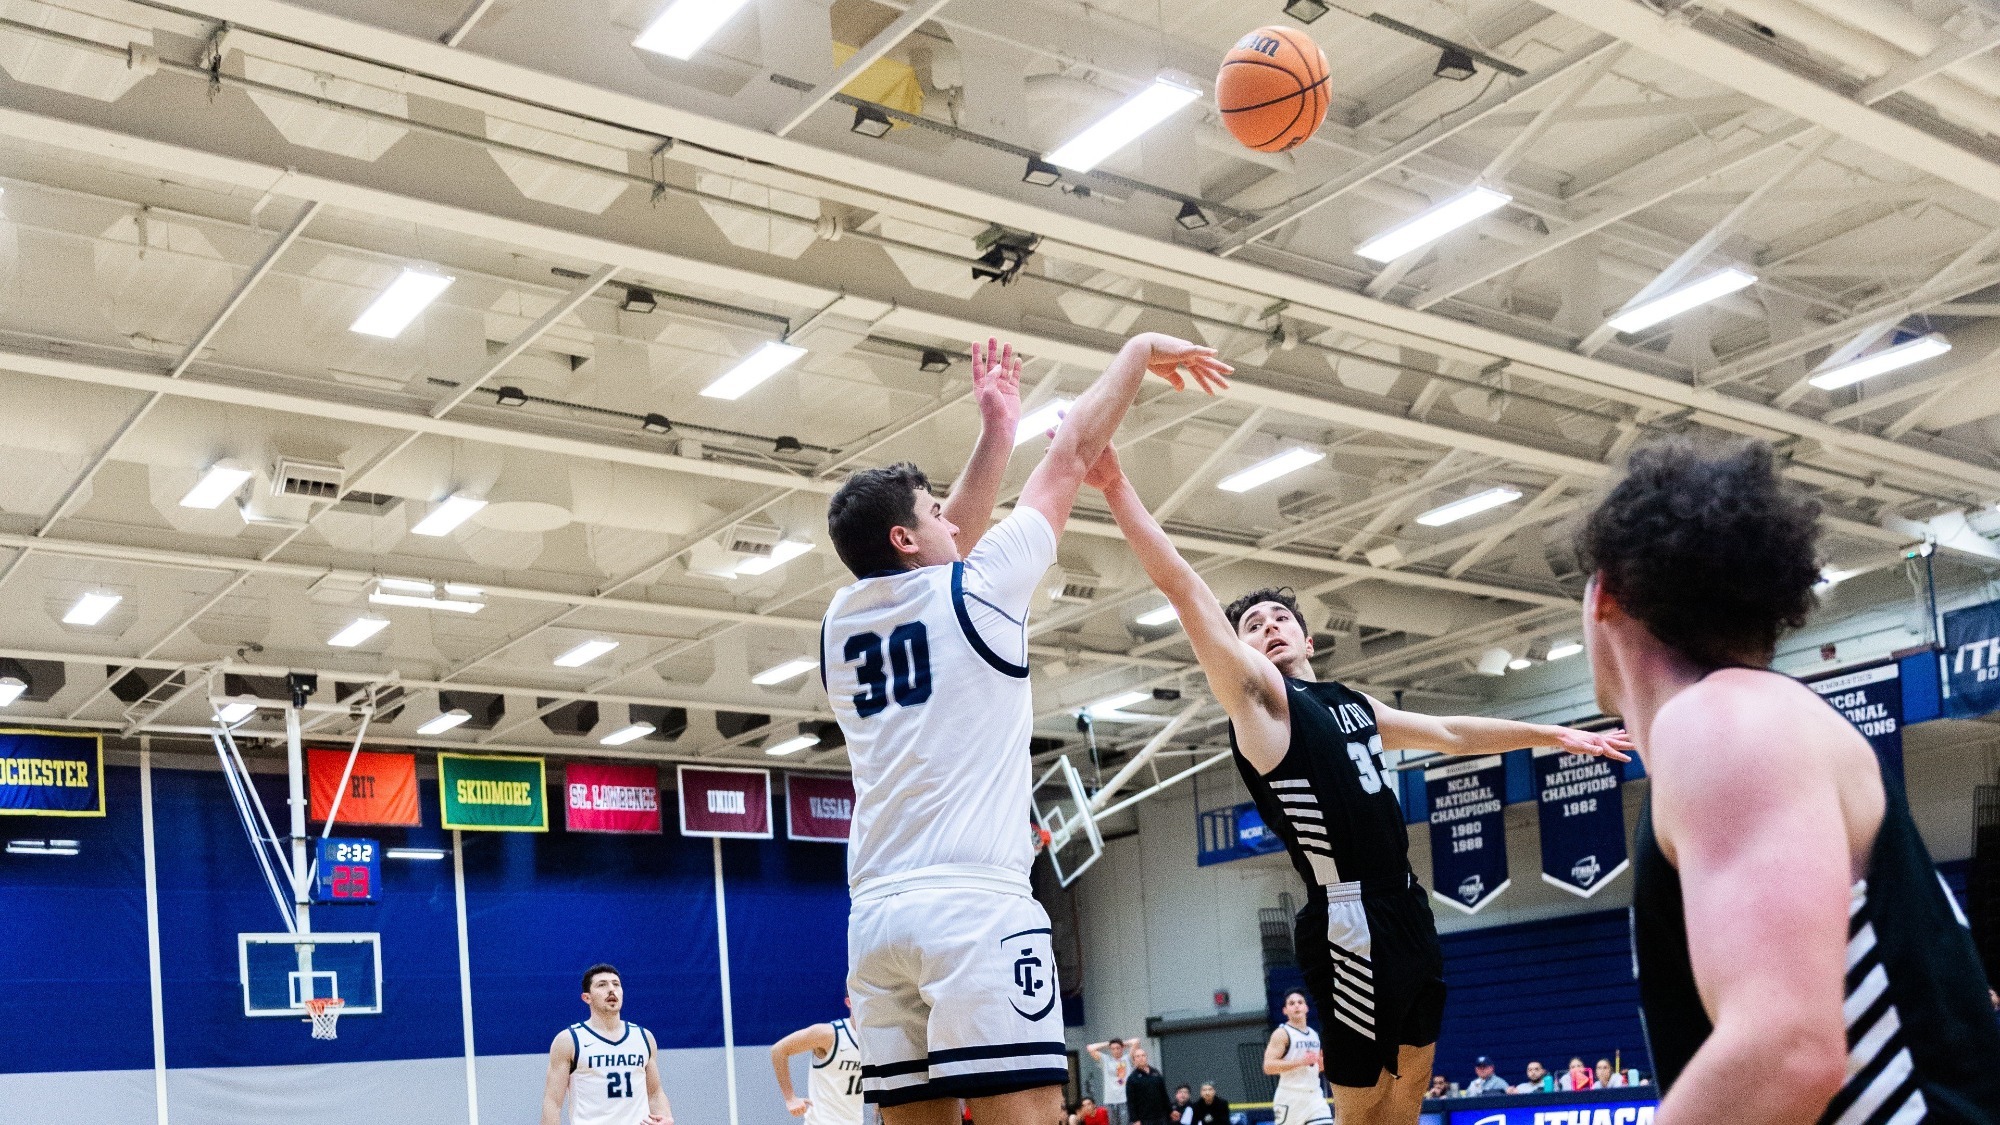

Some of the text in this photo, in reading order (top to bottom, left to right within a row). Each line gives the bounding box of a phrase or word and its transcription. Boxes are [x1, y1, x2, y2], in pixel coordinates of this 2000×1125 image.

[844, 620, 933, 719] 30
[1329, 703, 1375, 735] ARD
[1558, 754, 1595, 770] NCAA
[351, 775, 376, 798] RIT
[1447, 775, 1480, 793] NCAA
[1545, 761, 1611, 788] NATIONAL
[457, 779, 532, 806] SKIDMORE
[569, 784, 658, 811] ST. LAWRENCE
[1435, 786, 1495, 810] NATIONAL
[1541, 775, 1617, 803] CHAMPIONS
[707, 790, 746, 814] UNION
[809, 796, 852, 819] VASSAR
[1430, 799, 1502, 825] CHAMPIONS
[1451, 821, 1482, 838] 1980
[337, 843, 373, 862] 2:32
[333, 866, 369, 898] 23
[588, 1054, 645, 1069] ITHACA
[838, 1060, 862, 1071] ITH
[606, 1071, 633, 1098] 21
[845, 1075, 864, 1096] 10
